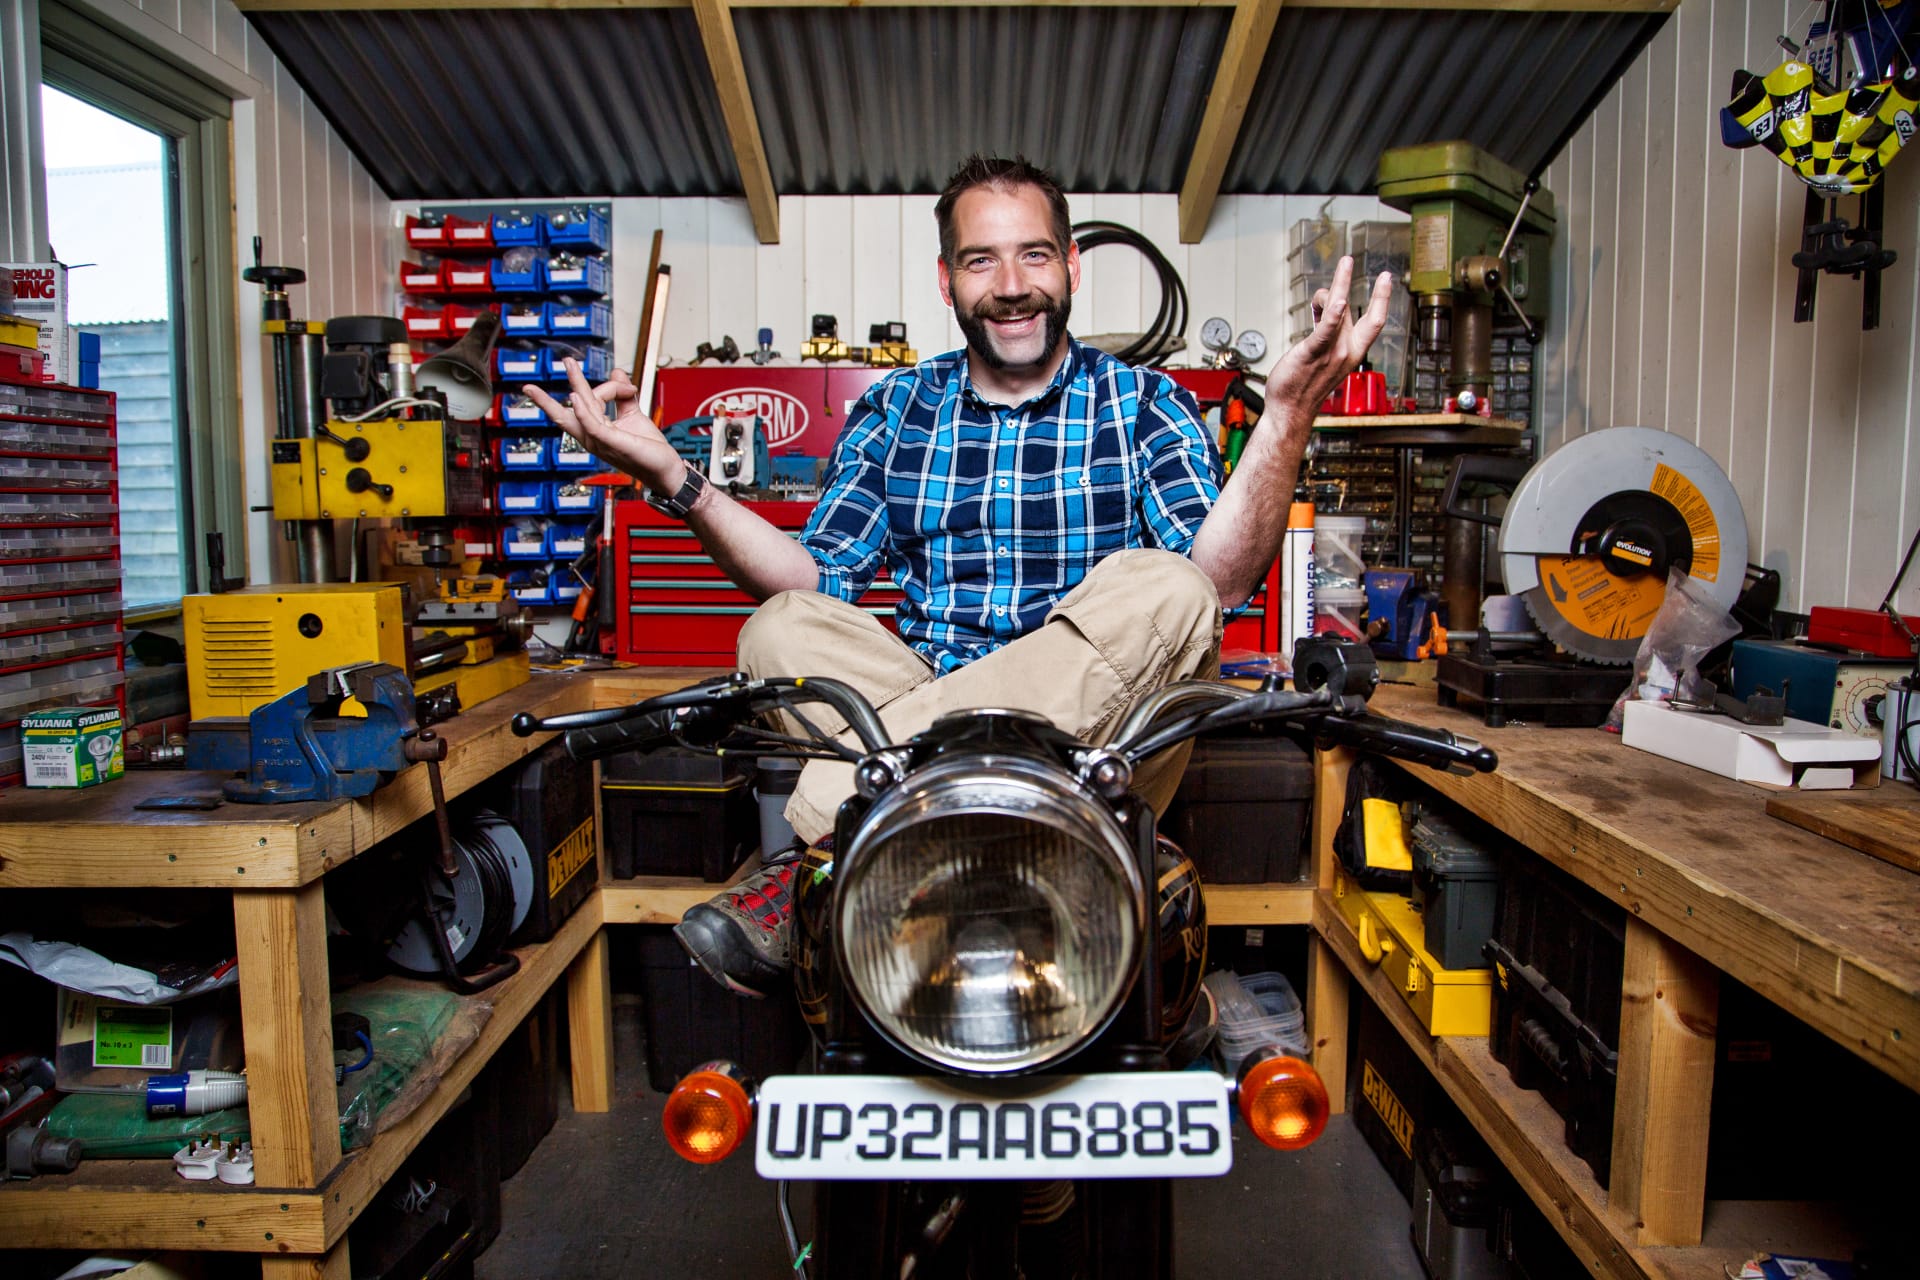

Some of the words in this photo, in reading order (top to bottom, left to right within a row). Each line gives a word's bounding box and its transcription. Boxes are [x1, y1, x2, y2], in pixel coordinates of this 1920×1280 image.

[21, 719, 73, 728] SYLVANIA
[78, 710, 120, 727] SYLVANIA
[767, 1101, 1219, 1160] UP32AA6885
